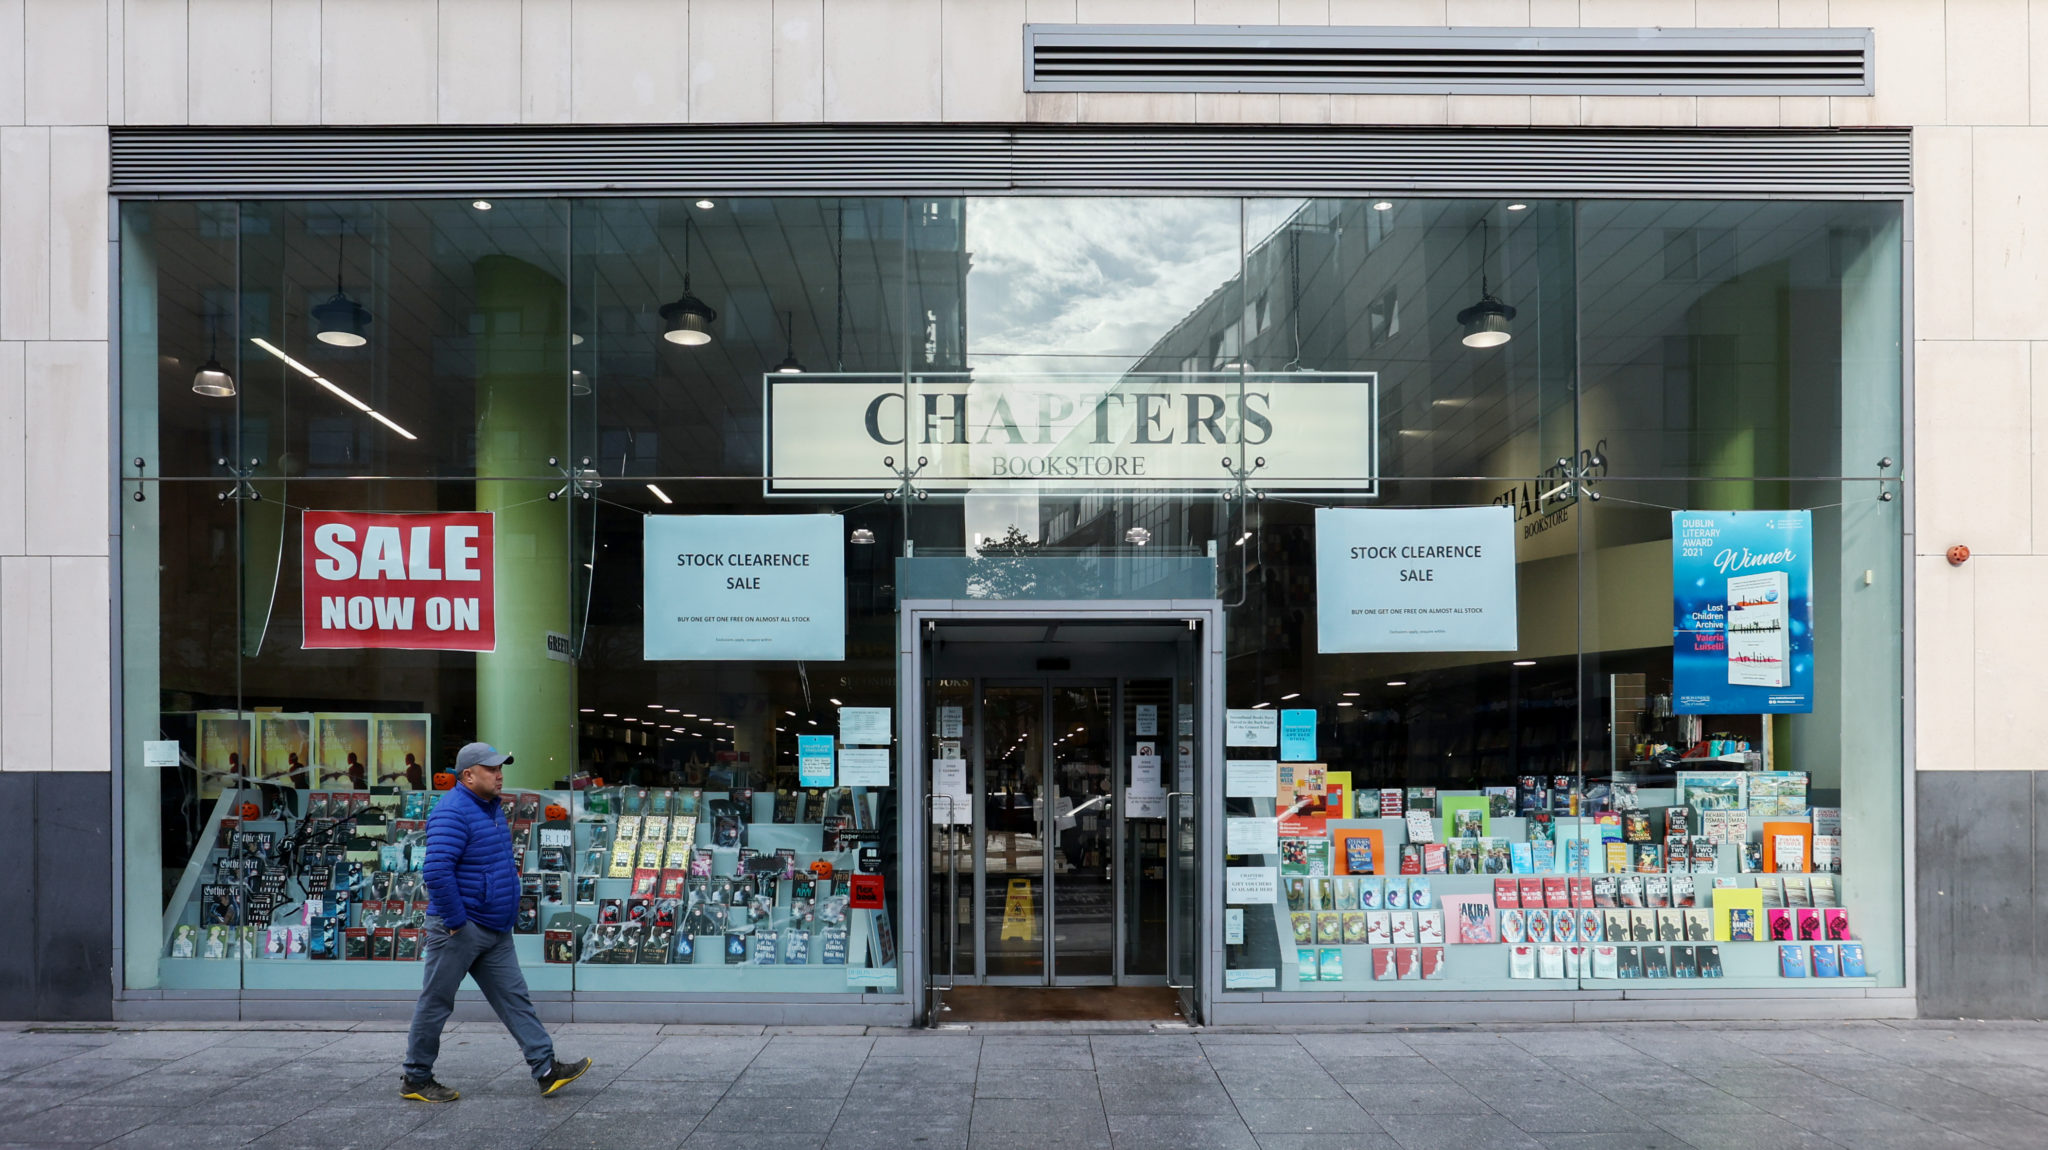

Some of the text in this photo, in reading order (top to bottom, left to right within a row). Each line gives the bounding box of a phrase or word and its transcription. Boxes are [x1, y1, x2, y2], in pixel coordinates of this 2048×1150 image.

[864, 391, 1273, 446] CHAPTERS
[991, 455, 1147, 477] BOOKSTORE
[1524, 509, 1568, 539] BOOKSTORE
[1682, 520, 1714, 528] DUBLIN
[1682, 528, 1720, 538] LITERARY
[1682, 538, 1714, 547] AWARD
[314, 523, 481, 581] SALE
[1350, 546, 1482, 559] STOCK CLEARENCE
[1682, 548, 1703, 556] 2021
[677, 553, 810, 566] STOCK CLEARENCE
[1713, 547, 1797, 574] Winner
[1400, 570, 1434, 582] SALE
[726, 577, 761, 590] SALE
[321, 596, 480, 631] NOW ON
[1707, 604, 1724, 612] Lost
[1696, 620, 1724, 628] Archive
[1694, 642, 1724, 650] Luiselli
[233, 834, 255, 842] Gthic
[220, 860, 240, 868] Gothi
[1461, 903, 1490, 920] AKIRA
